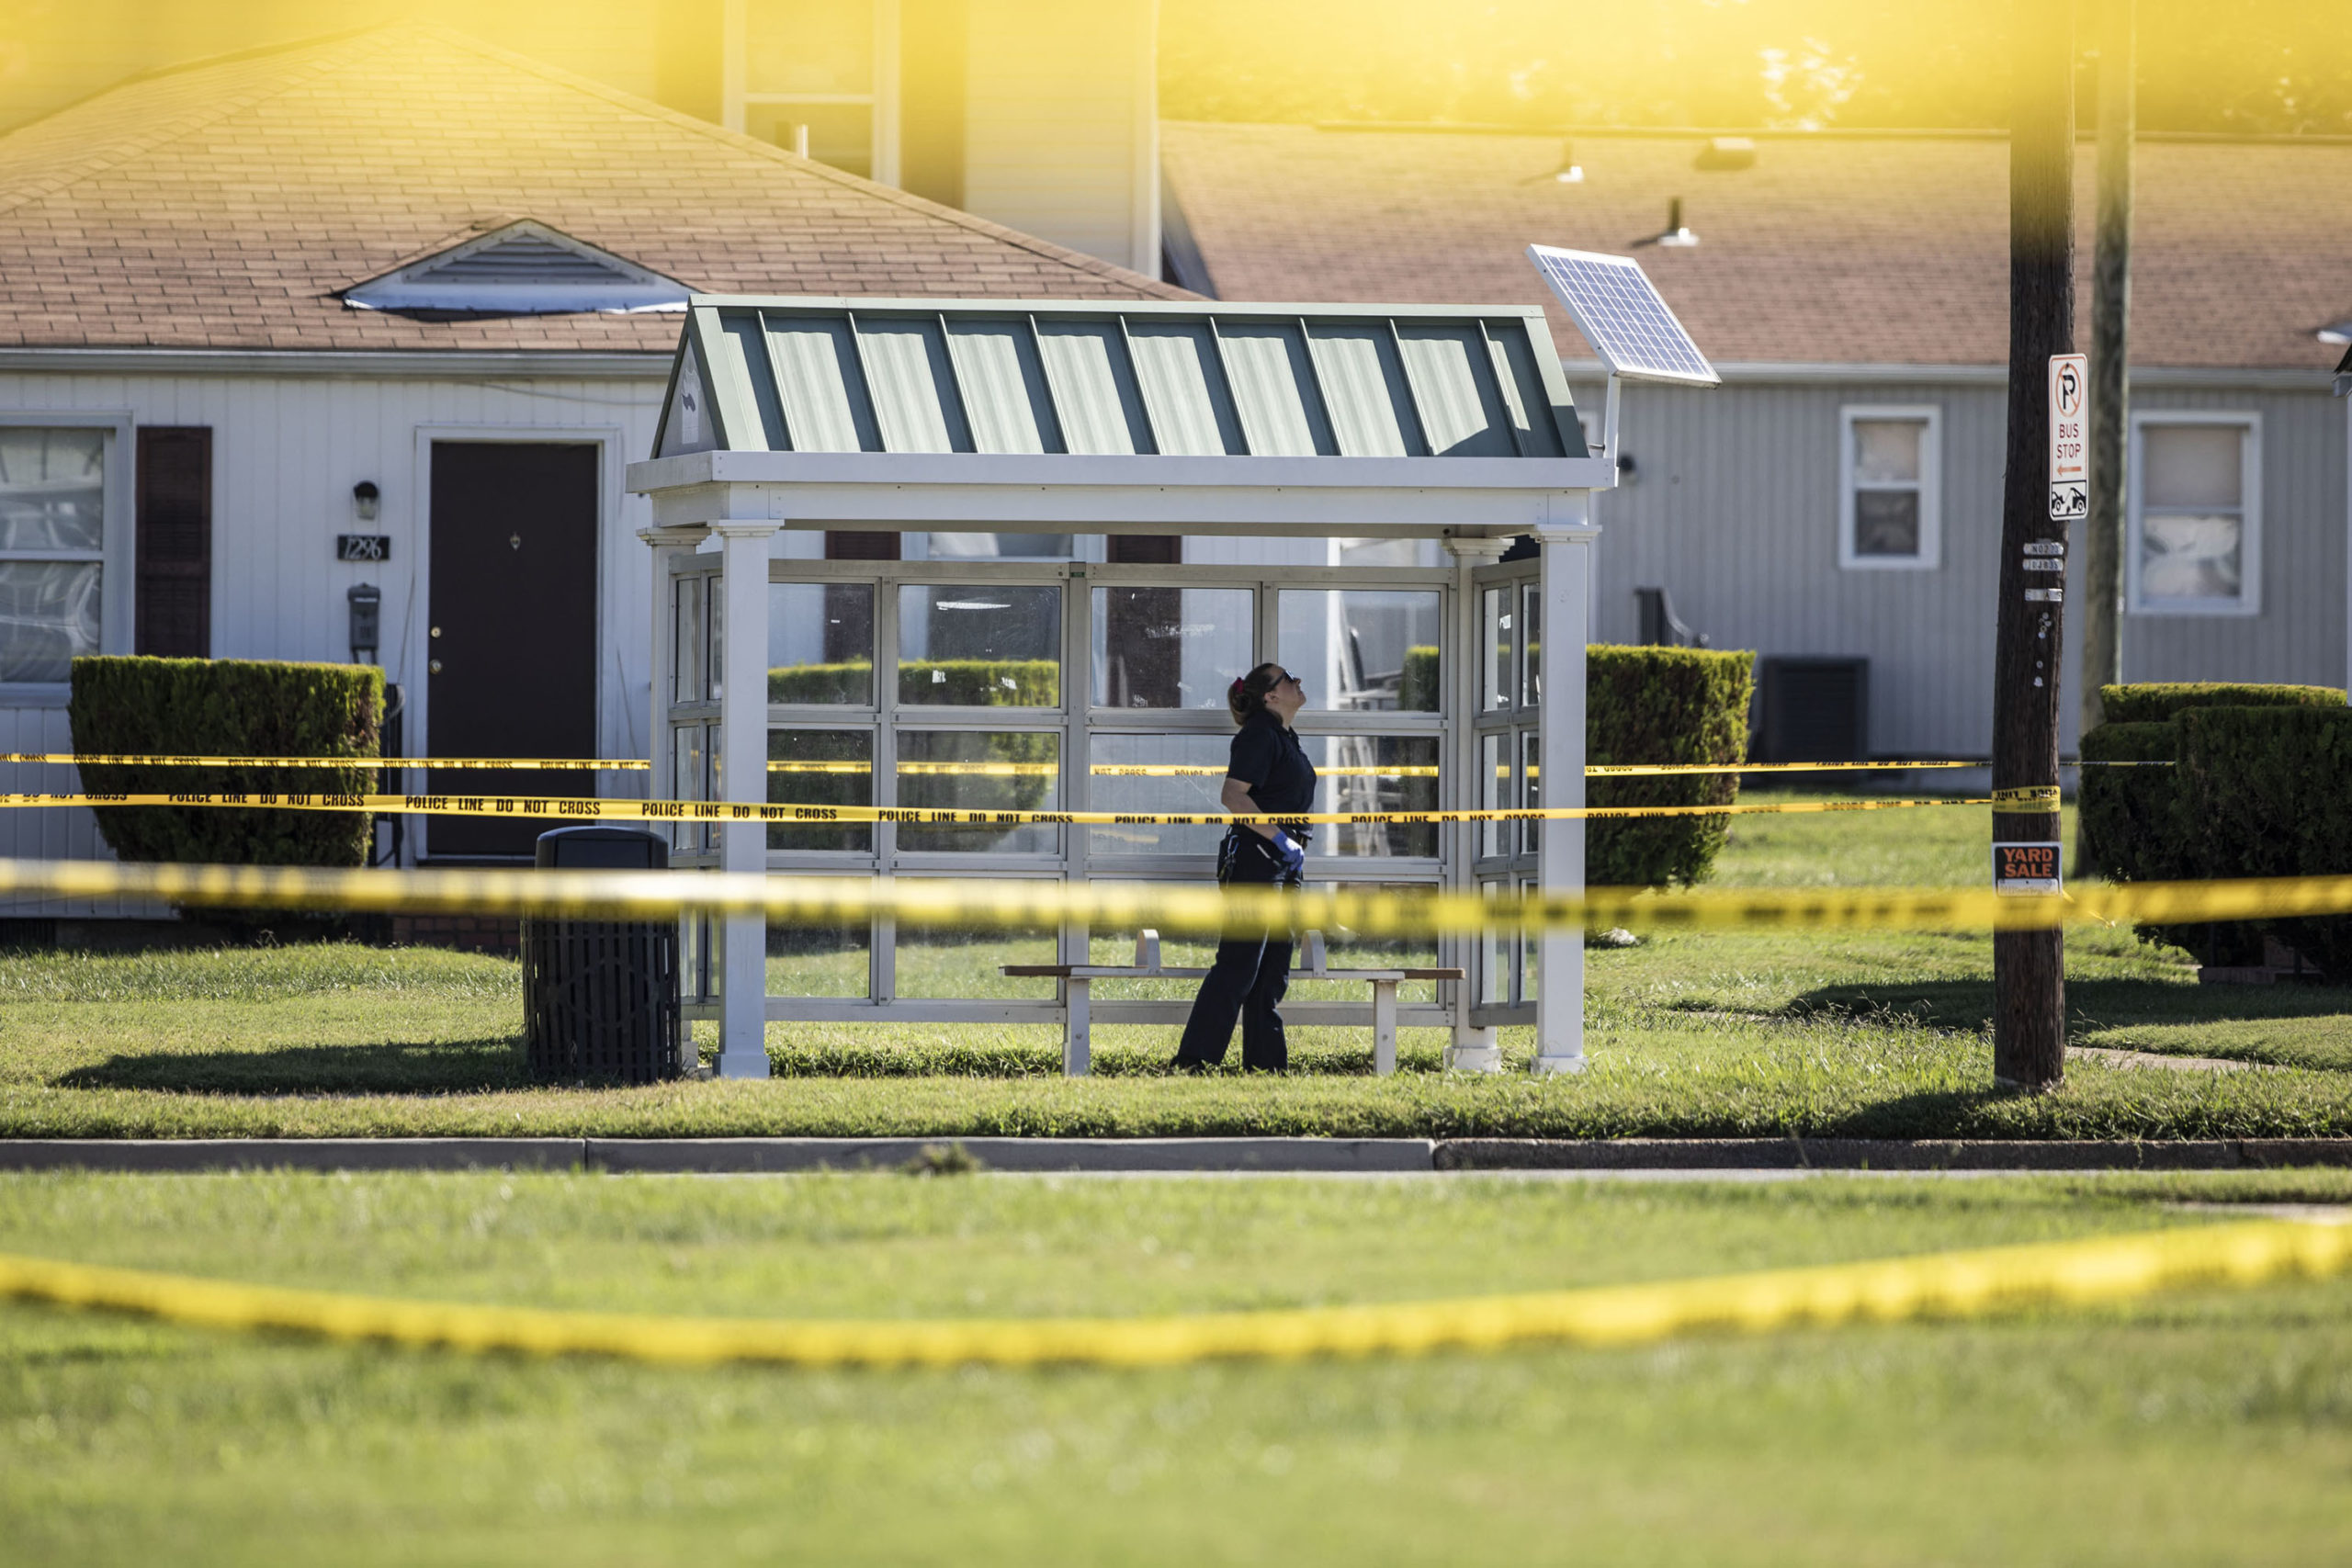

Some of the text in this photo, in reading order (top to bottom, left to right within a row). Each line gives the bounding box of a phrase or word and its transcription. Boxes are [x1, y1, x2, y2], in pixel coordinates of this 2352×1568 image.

[2059, 423, 2079, 438] BUS
[2057, 444, 2081, 458] STOP
[222, 794, 247, 804] LINE
[260, 794, 277, 805] DO
[288, 794, 312, 806] NOT
[322, 794, 365, 807] CROSS
[405, 795, 601, 815] POLICE LINE DO NOT CROSS
[642, 803, 837, 819] POLICE LINE DO NOT CROSS
[878, 809, 921, 821] POLICE
[932, 811, 957, 822] LINE
[969, 812, 986, 823] DO
[997, 813, 1022, 823] NOT
[1114, 816, 1157, 824] POLICE
[2003, 848, 2053, 863] YARD
[2005, 863, 2052, 878] SALE
